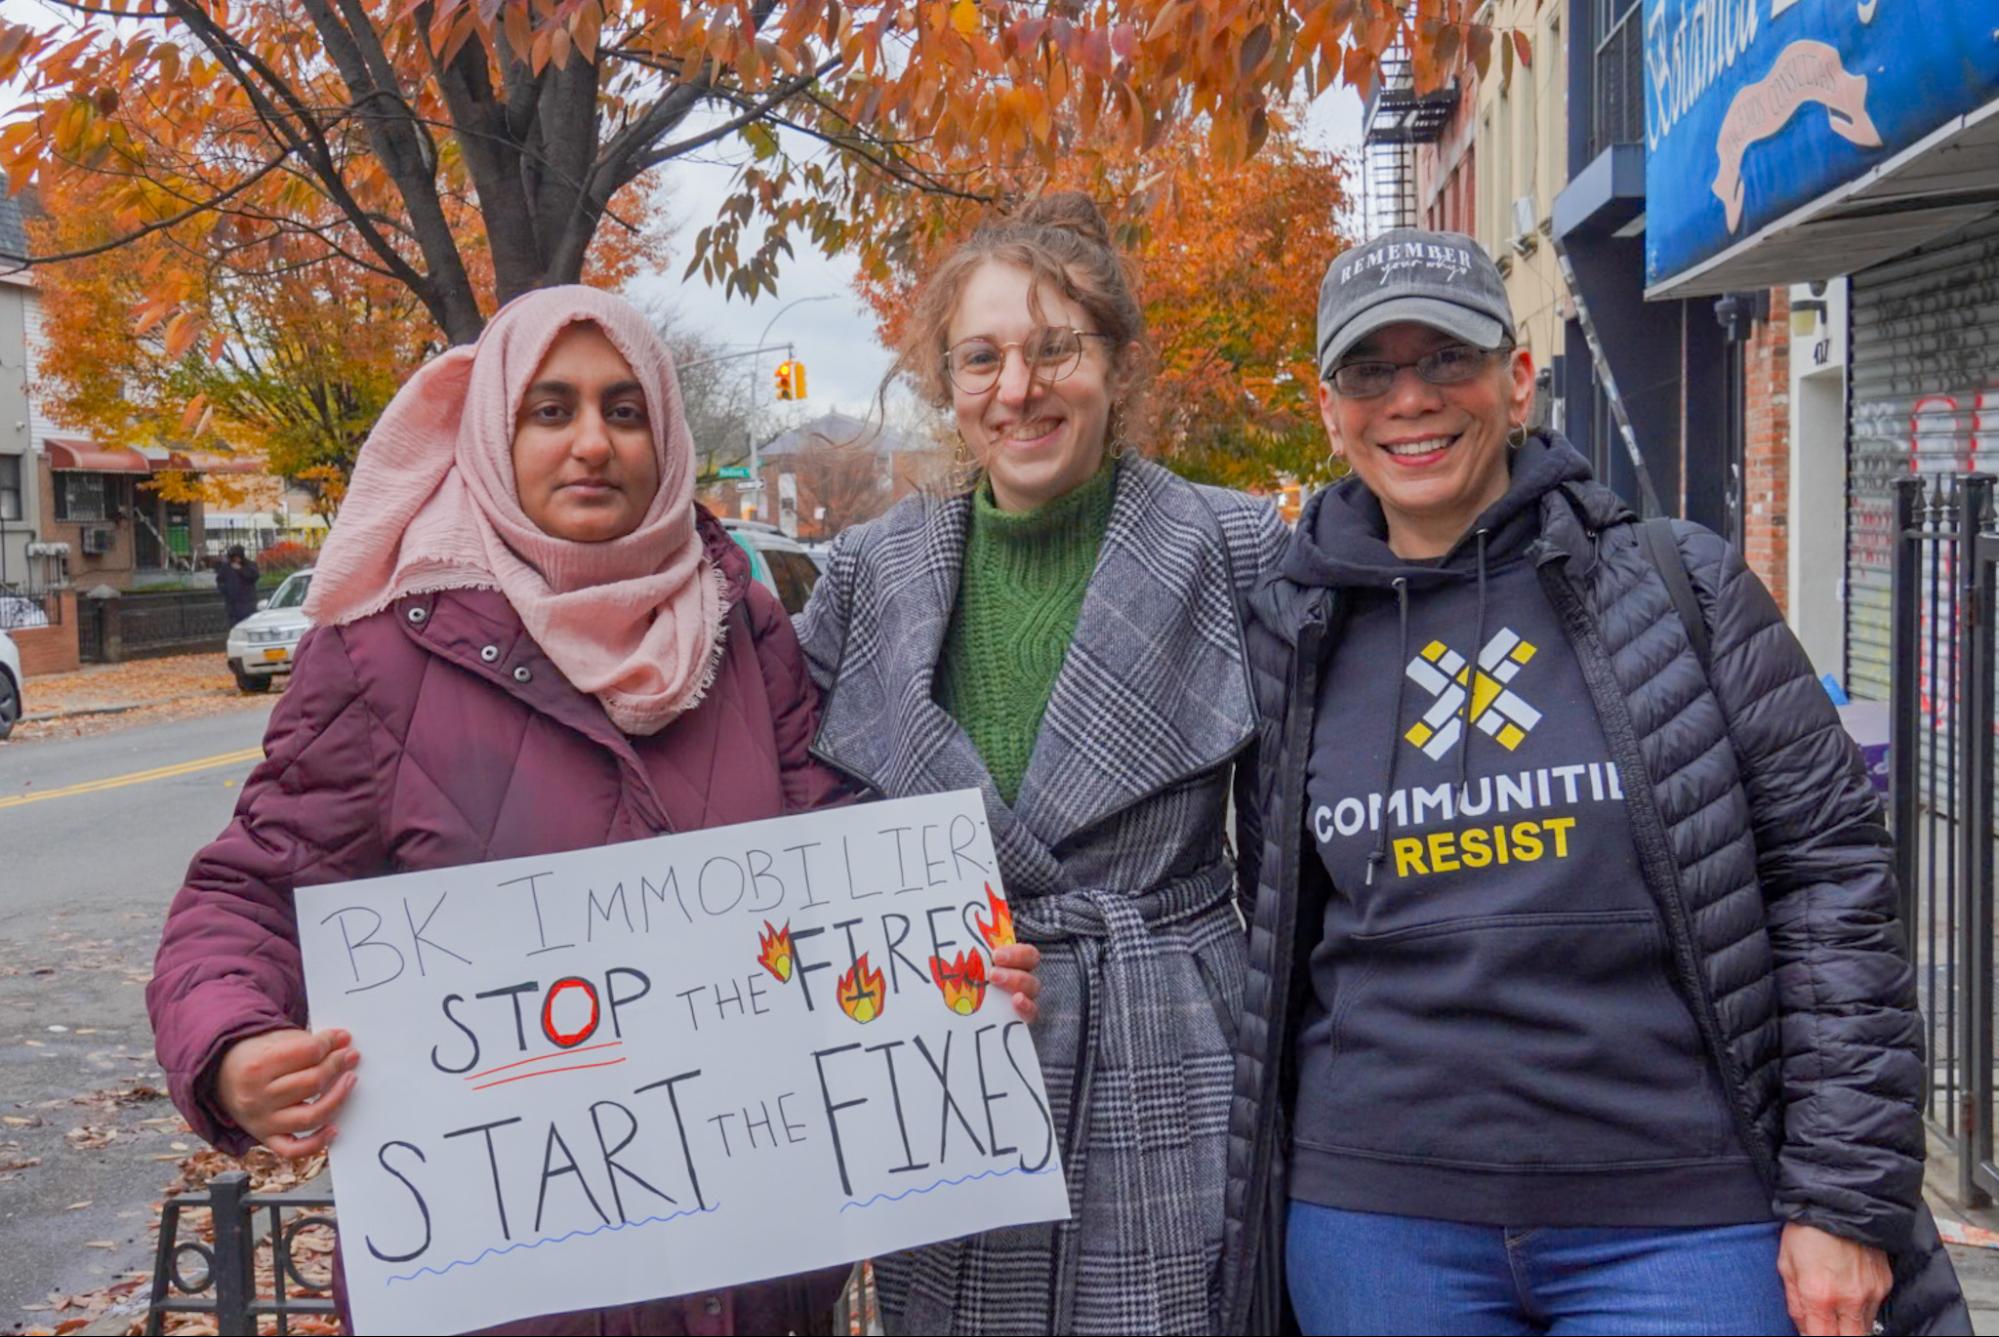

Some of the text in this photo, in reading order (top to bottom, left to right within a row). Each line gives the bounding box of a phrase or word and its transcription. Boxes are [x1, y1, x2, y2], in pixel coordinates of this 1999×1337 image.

[1340, 242, 1472, 285] REMEMBER
[1380, 259, 1423, 285] your
[320, 813, 993, 995] BK IMMOBILIER:
[1392, 816, 1576, 878] RESIST
[430, 900, 1000, 1074] STOP THE FIRES
[365, 1020, 1053, 1263] START THE FIXES
